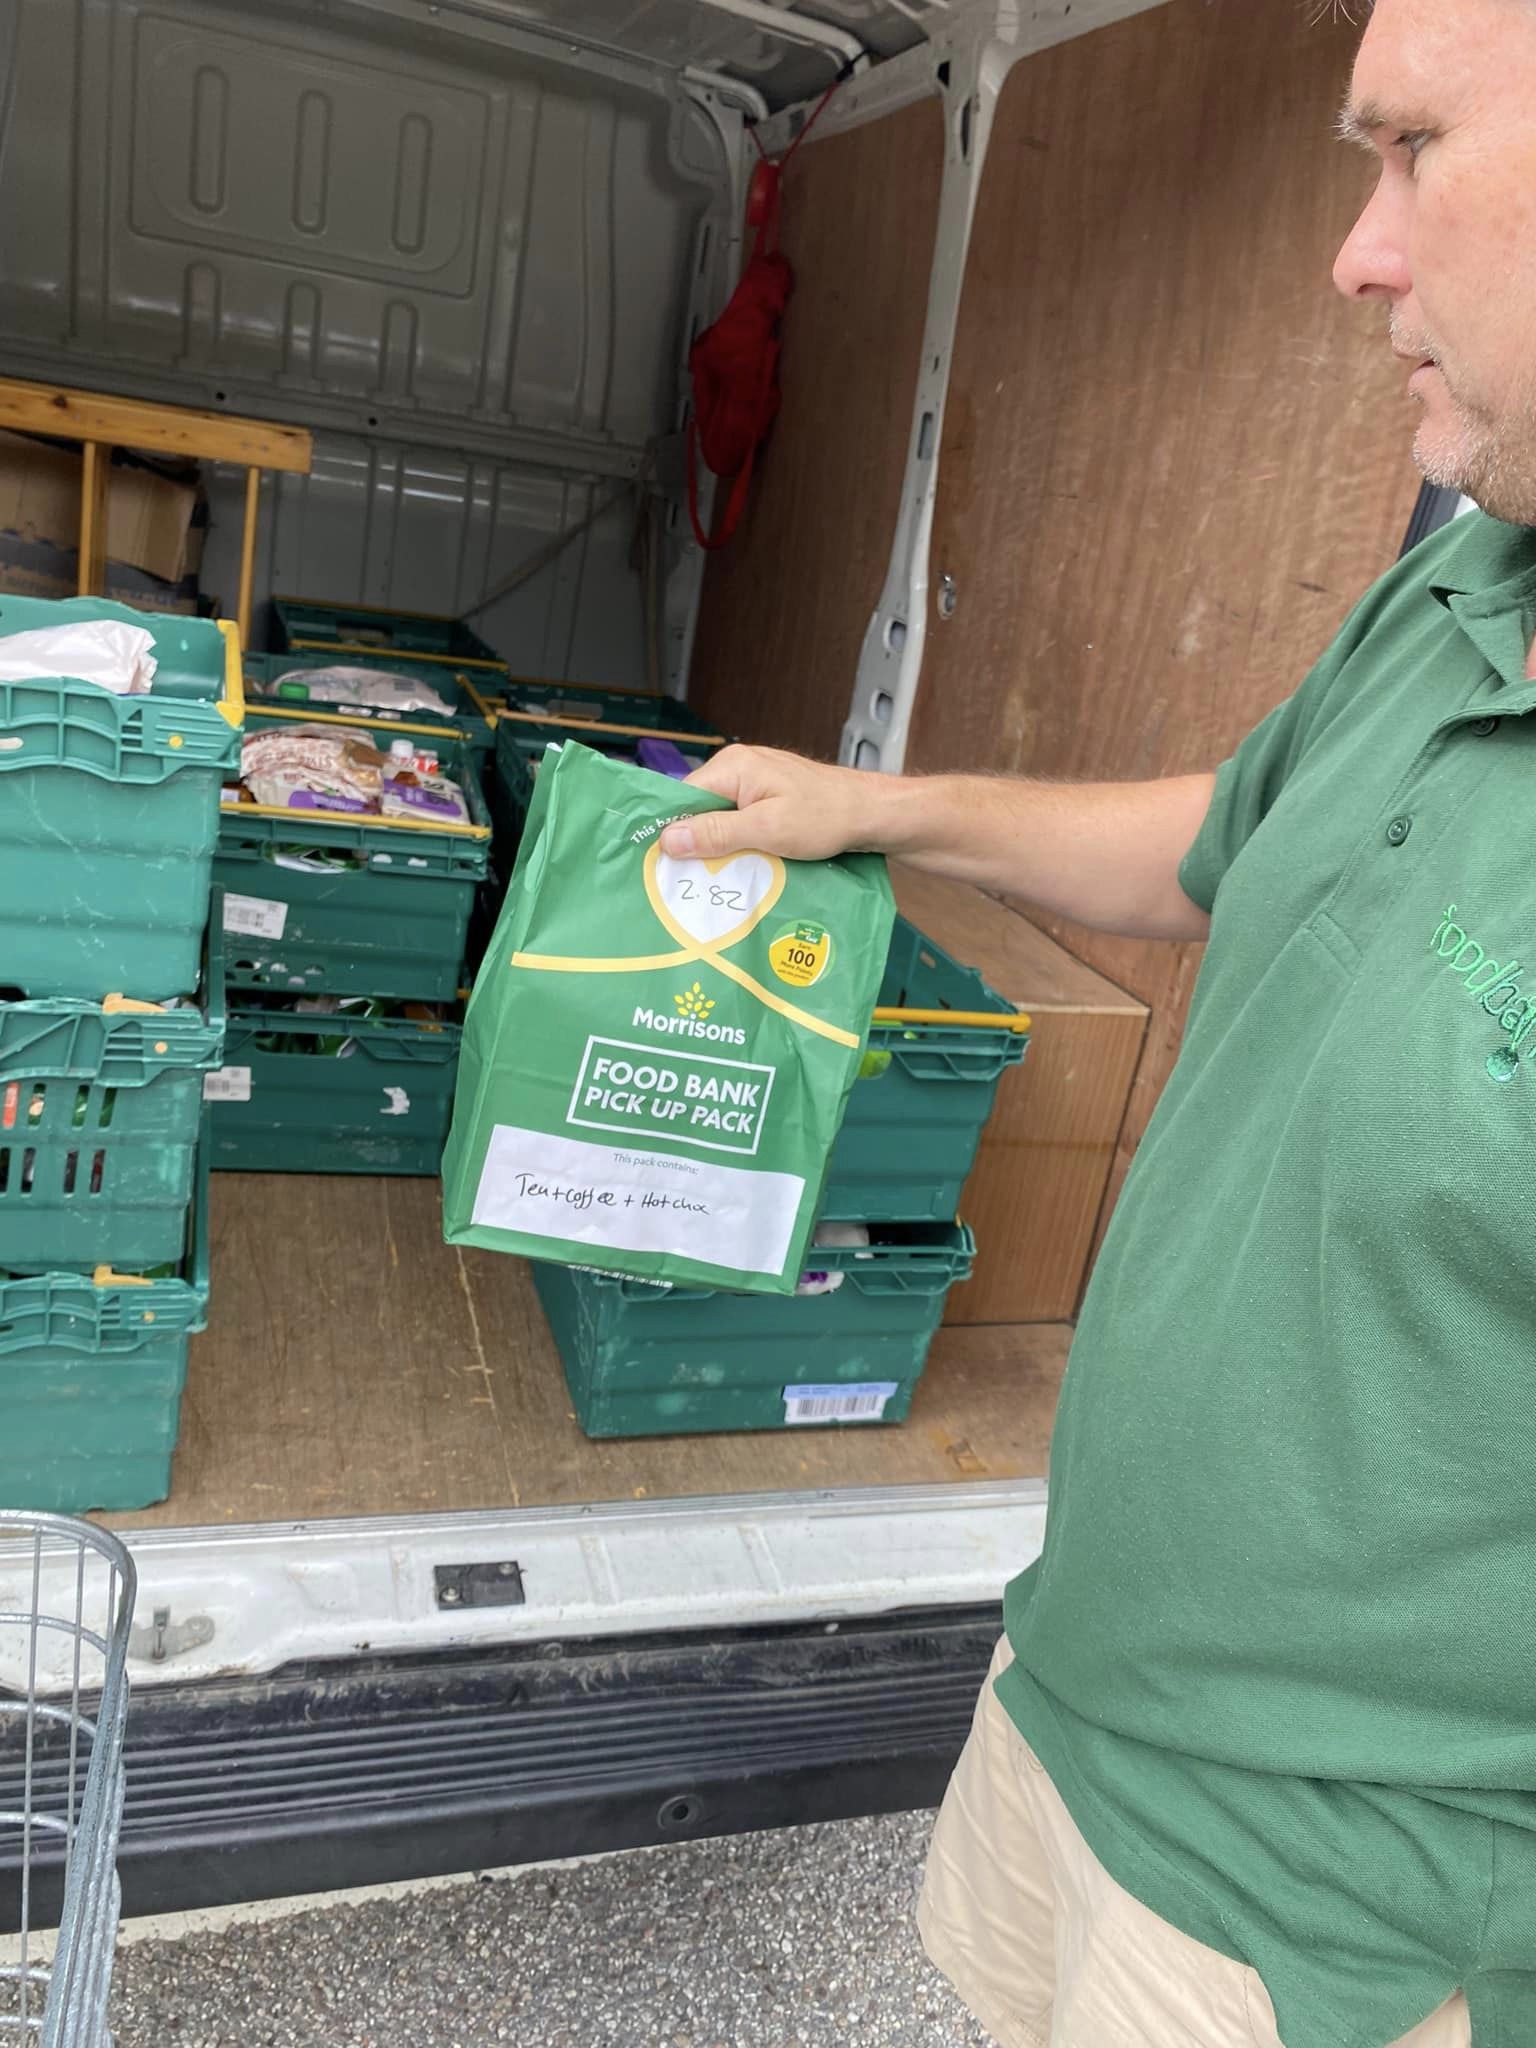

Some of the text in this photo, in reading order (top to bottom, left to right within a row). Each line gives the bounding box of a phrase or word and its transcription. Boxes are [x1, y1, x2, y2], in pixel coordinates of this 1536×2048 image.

[630, 825, 656, 844] This
[788, 948, 815, 968] 100
[632, 1006, 746, 1046] Morrisons
[592, 1057, 761, 1108] FOOD BANK
[584, 1086, 755, 1134] PICK UP PACK
[613, 1153, 631, 1164] This
[633, 1157, 655, 1167] pack
